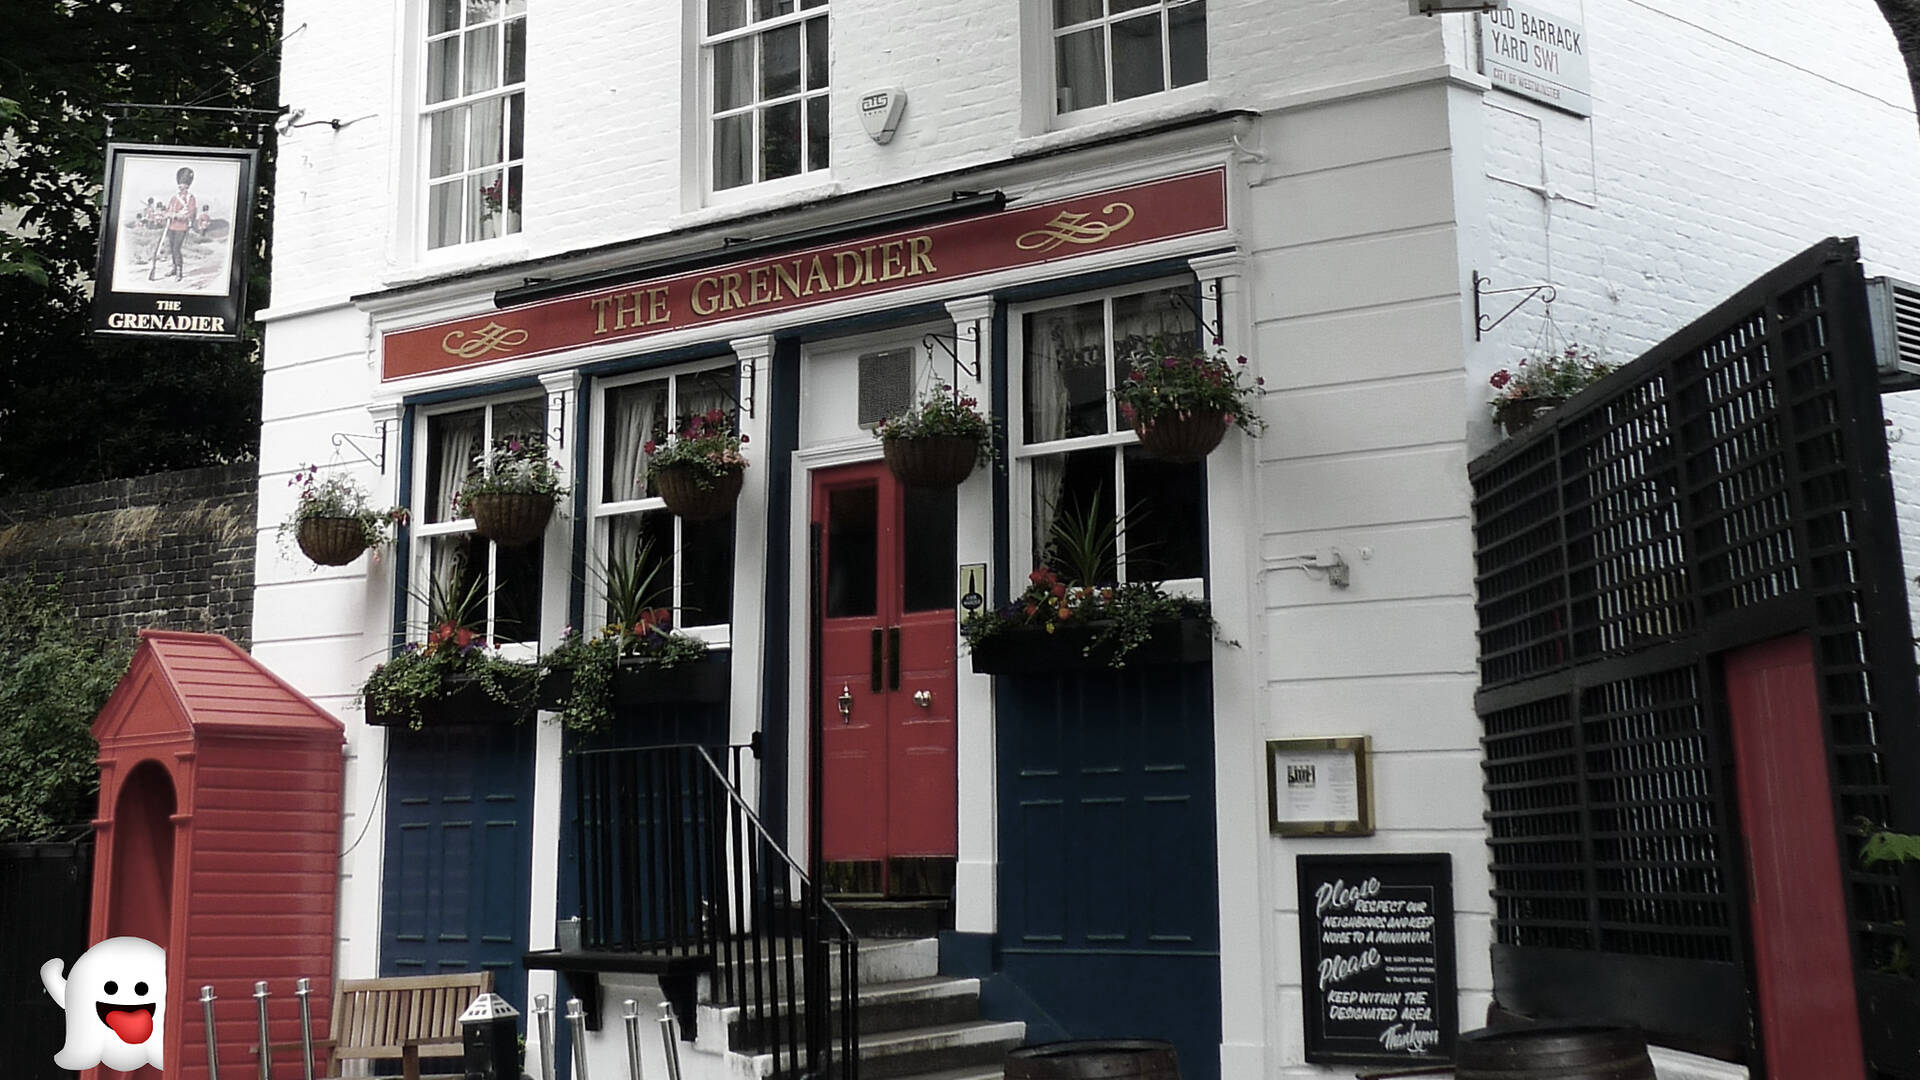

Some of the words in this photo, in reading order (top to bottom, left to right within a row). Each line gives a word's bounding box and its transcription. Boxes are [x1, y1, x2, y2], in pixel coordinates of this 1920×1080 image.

[1490, 8, 1515, 30] OLD
[1521, 13, 1582, 55] BARRACK
[1492, 29, 1528, 63] YARD
[1534, 45, 1559, 75] SW1
[1493, 67, 1507, 82] CITY
[1509, 73, 1517, 85] OF
[1518, 77, 1561, 99] WESTMINSTER
[590, 285, 672, 335] THE
[691, 235, 937, 316] GRENADIER
[156, 300, 181, 311] THE
[108, 312, 225, 332] GRENADIER
[1315, 877, 1380, 918] Please
[1354, 899, 1406, 913] RESPECT
[1406, 901, 1427, 913] OUR
[1322, 916, 1387, 929] NEIGHBOURS
[1387, 917, 1408, 929] AND
[1408, 916, 1435, 929] KEEP
[1322, 931, 1351, 944] NOISE
[1351, 931, 1365, 944] TO
[1366, 931, 1374, 944] A
[1318, 947, 1381, 991] Please
[1327, 989, 1358, 1003] KEEP
[1358, 992, 1402, 1005] WITHIN
[1404, 991, 1429, 1005] THE
[1329, 1005, 1398, 1021] DESIGNATED
